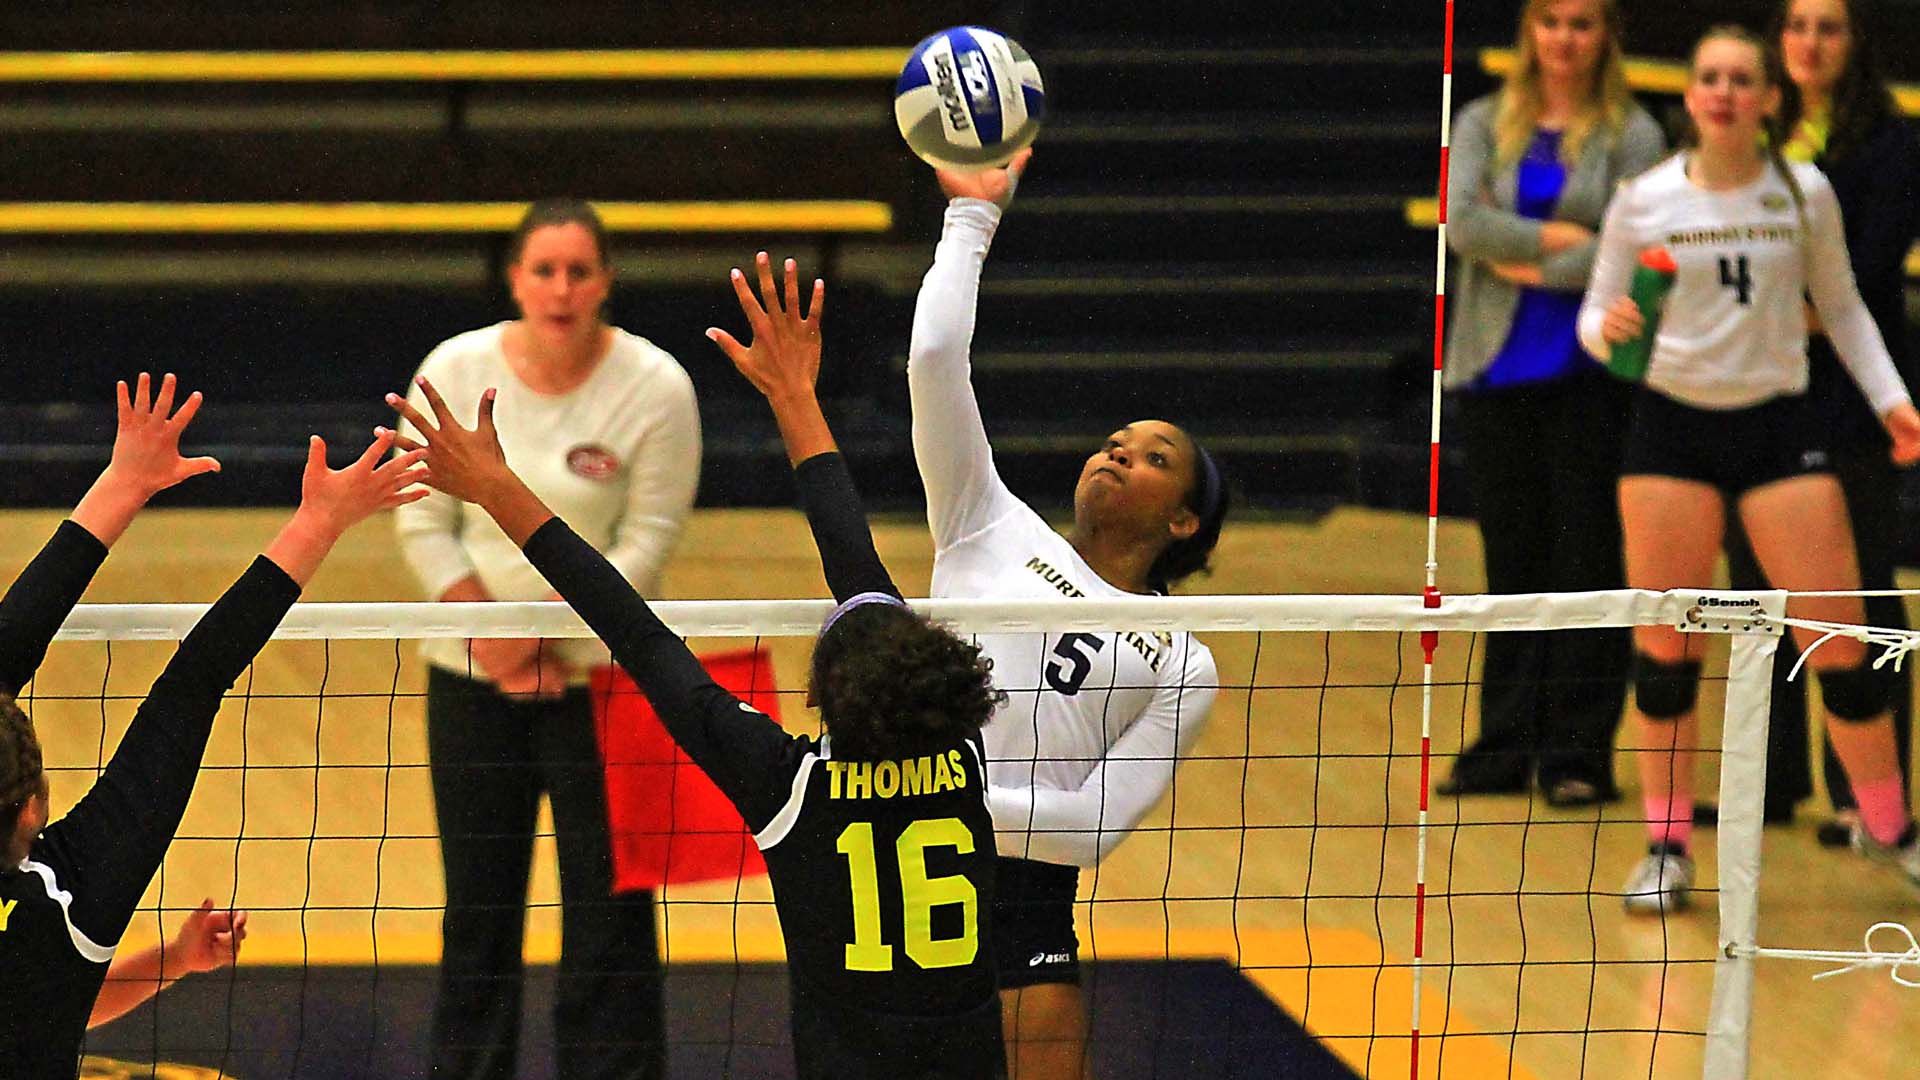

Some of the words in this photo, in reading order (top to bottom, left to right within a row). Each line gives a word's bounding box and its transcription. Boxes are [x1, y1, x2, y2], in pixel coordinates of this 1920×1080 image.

[1717, 253, 1752, 306] 4
[1025, 557, 1085, 597] MURR
[1708, 598, 1760, 607] Senoh
[1045, 632, 1104, 696] 5
[1117, 632, 1160, 673] TATE
[826, 749, 967, 799] THOMAS
[837, 817, 979, 972] 16
